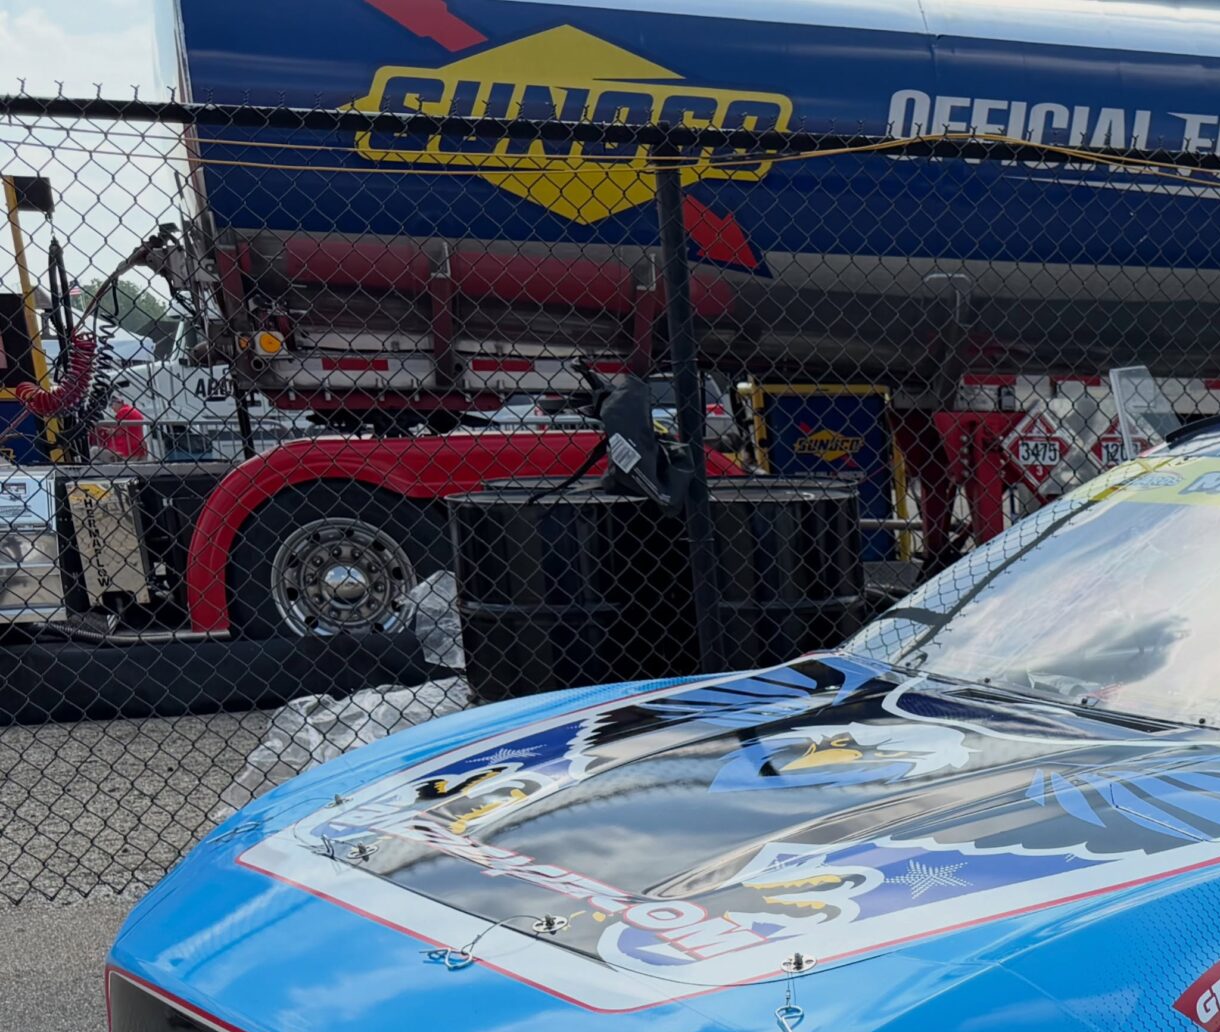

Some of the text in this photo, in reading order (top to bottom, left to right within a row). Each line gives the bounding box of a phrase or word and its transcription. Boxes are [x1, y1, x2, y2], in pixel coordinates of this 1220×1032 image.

[369, 75, 782, 172] SUNOCO
[886, 88, 1152, 174] OFFICIAL
[1021, 441, 1059, 463] 3475
